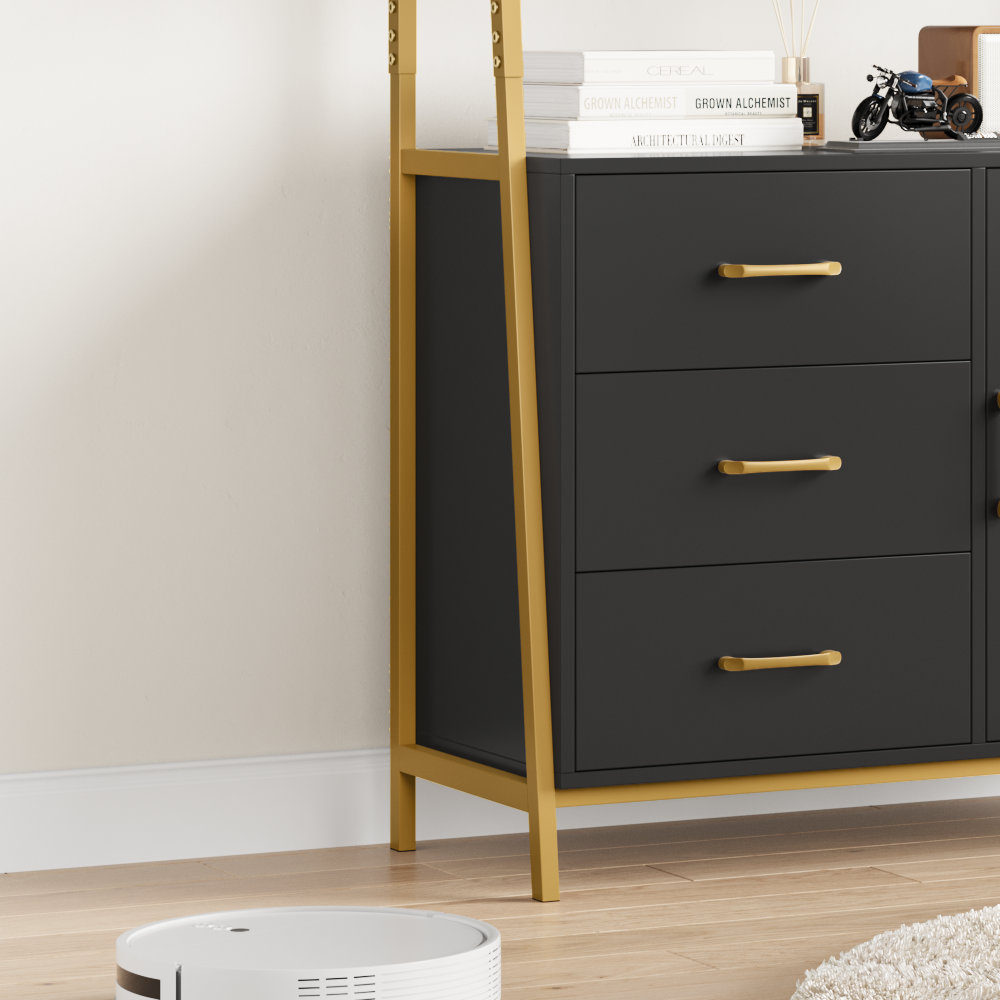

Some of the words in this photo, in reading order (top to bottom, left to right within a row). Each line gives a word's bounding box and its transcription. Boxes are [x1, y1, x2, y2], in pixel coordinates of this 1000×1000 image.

[646, 65, 713, 76] CEREAL
[584, 97, 621, 109] GROWN
[624, 96, 678, 109] ALCHEMIST
[695, 98, 732, 109] GROWN
[735, 97, 791, 108] ALCHEMIST
